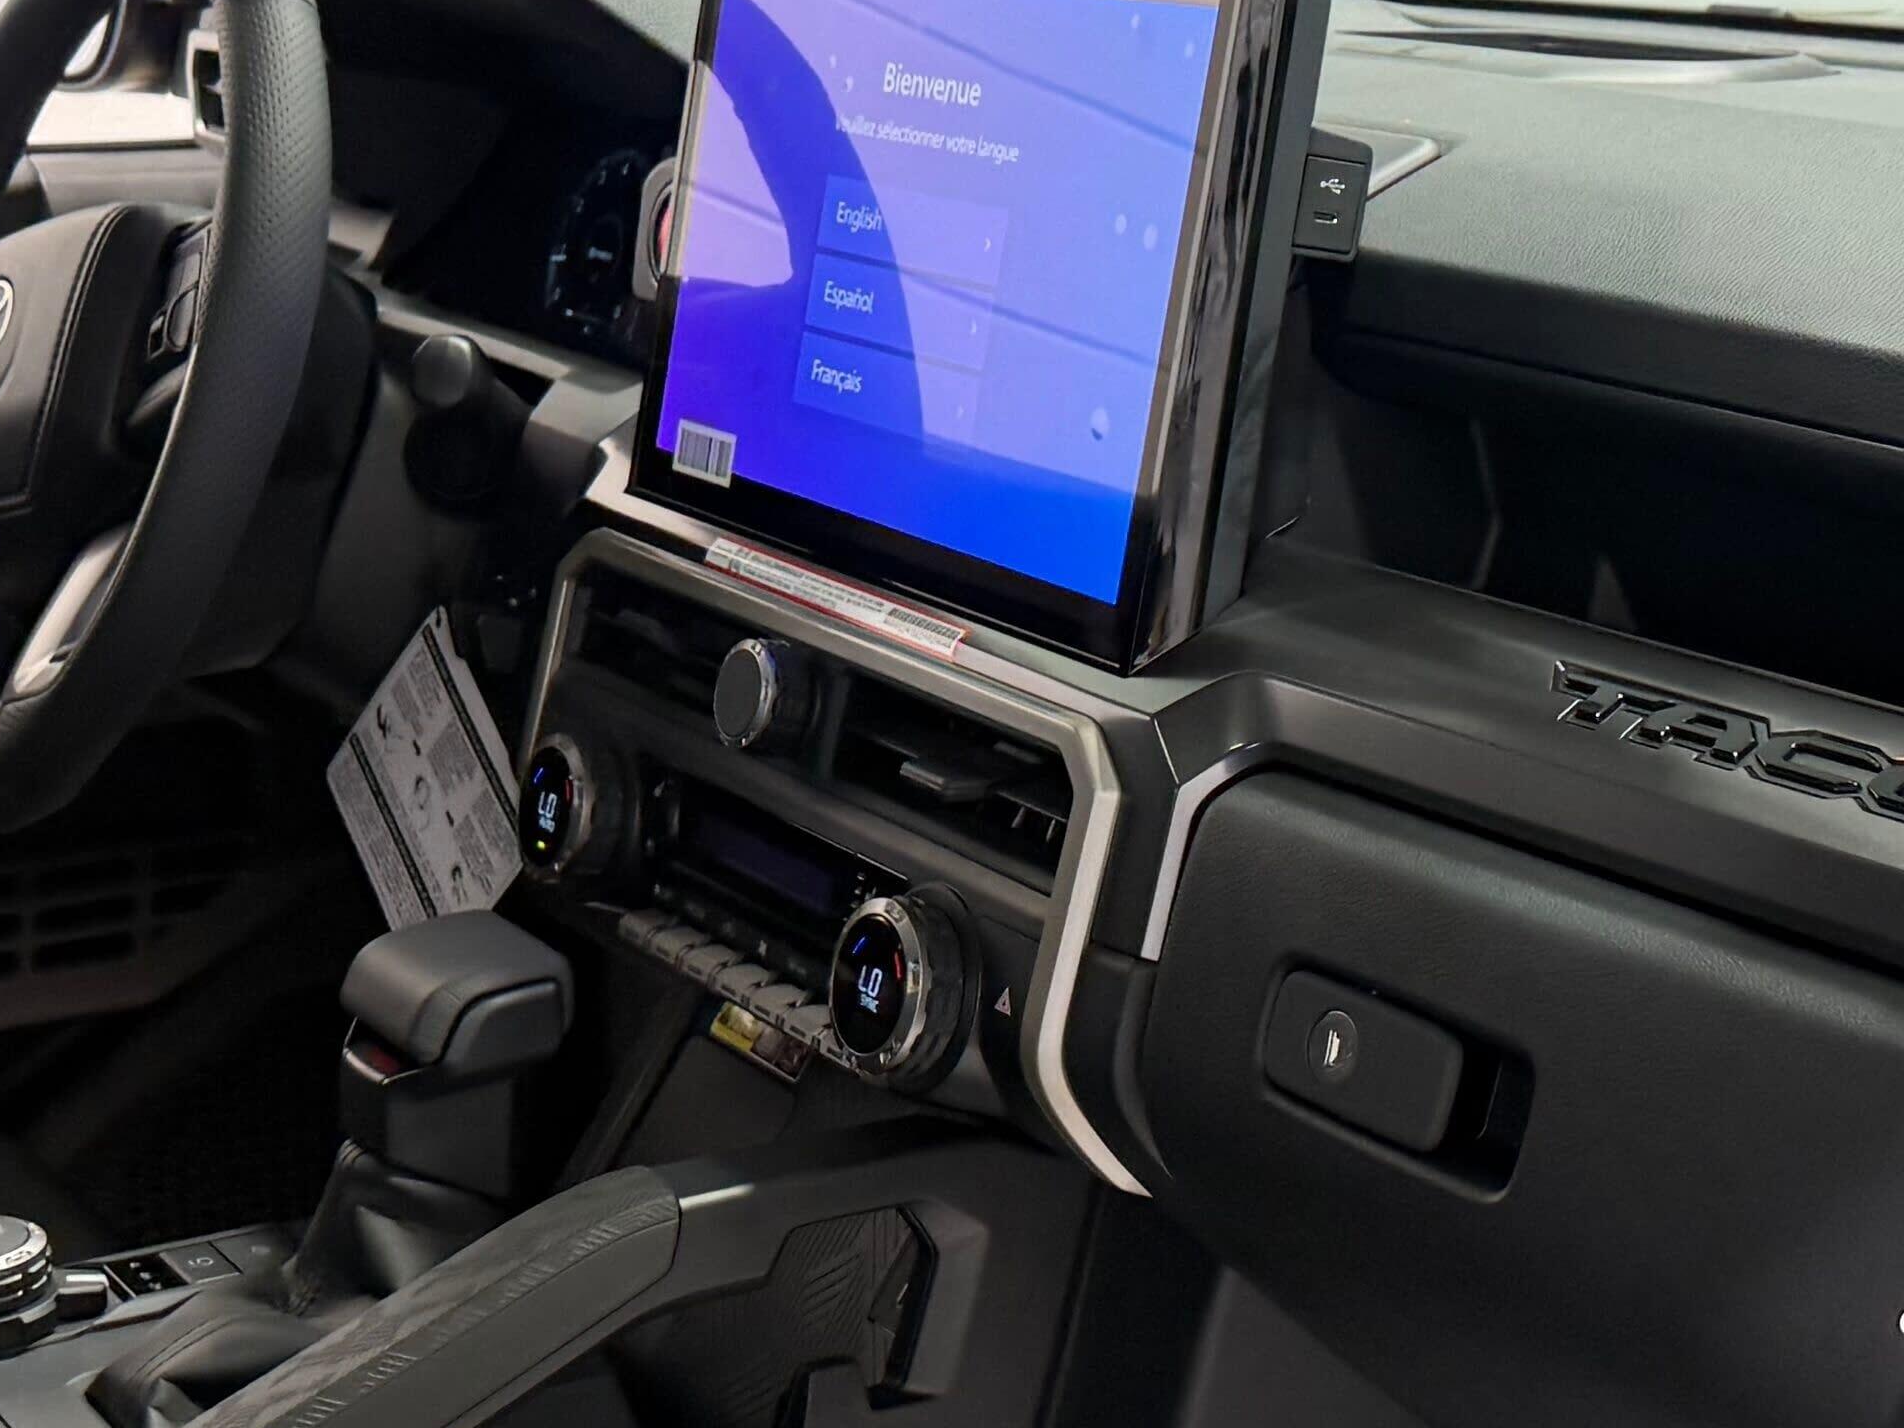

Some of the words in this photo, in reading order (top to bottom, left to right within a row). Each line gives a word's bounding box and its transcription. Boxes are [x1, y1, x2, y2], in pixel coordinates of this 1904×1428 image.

[883, 61, 982, 107] Bienvenue
[946, 133, 976, 155] votre
[976, 134, 1020, 165] langue
[836, 201, 882, 233] English
[824, 280, 874, 315] Español
[810, 358, 863, 394] Français
[858, 965, 883, 998] LO
